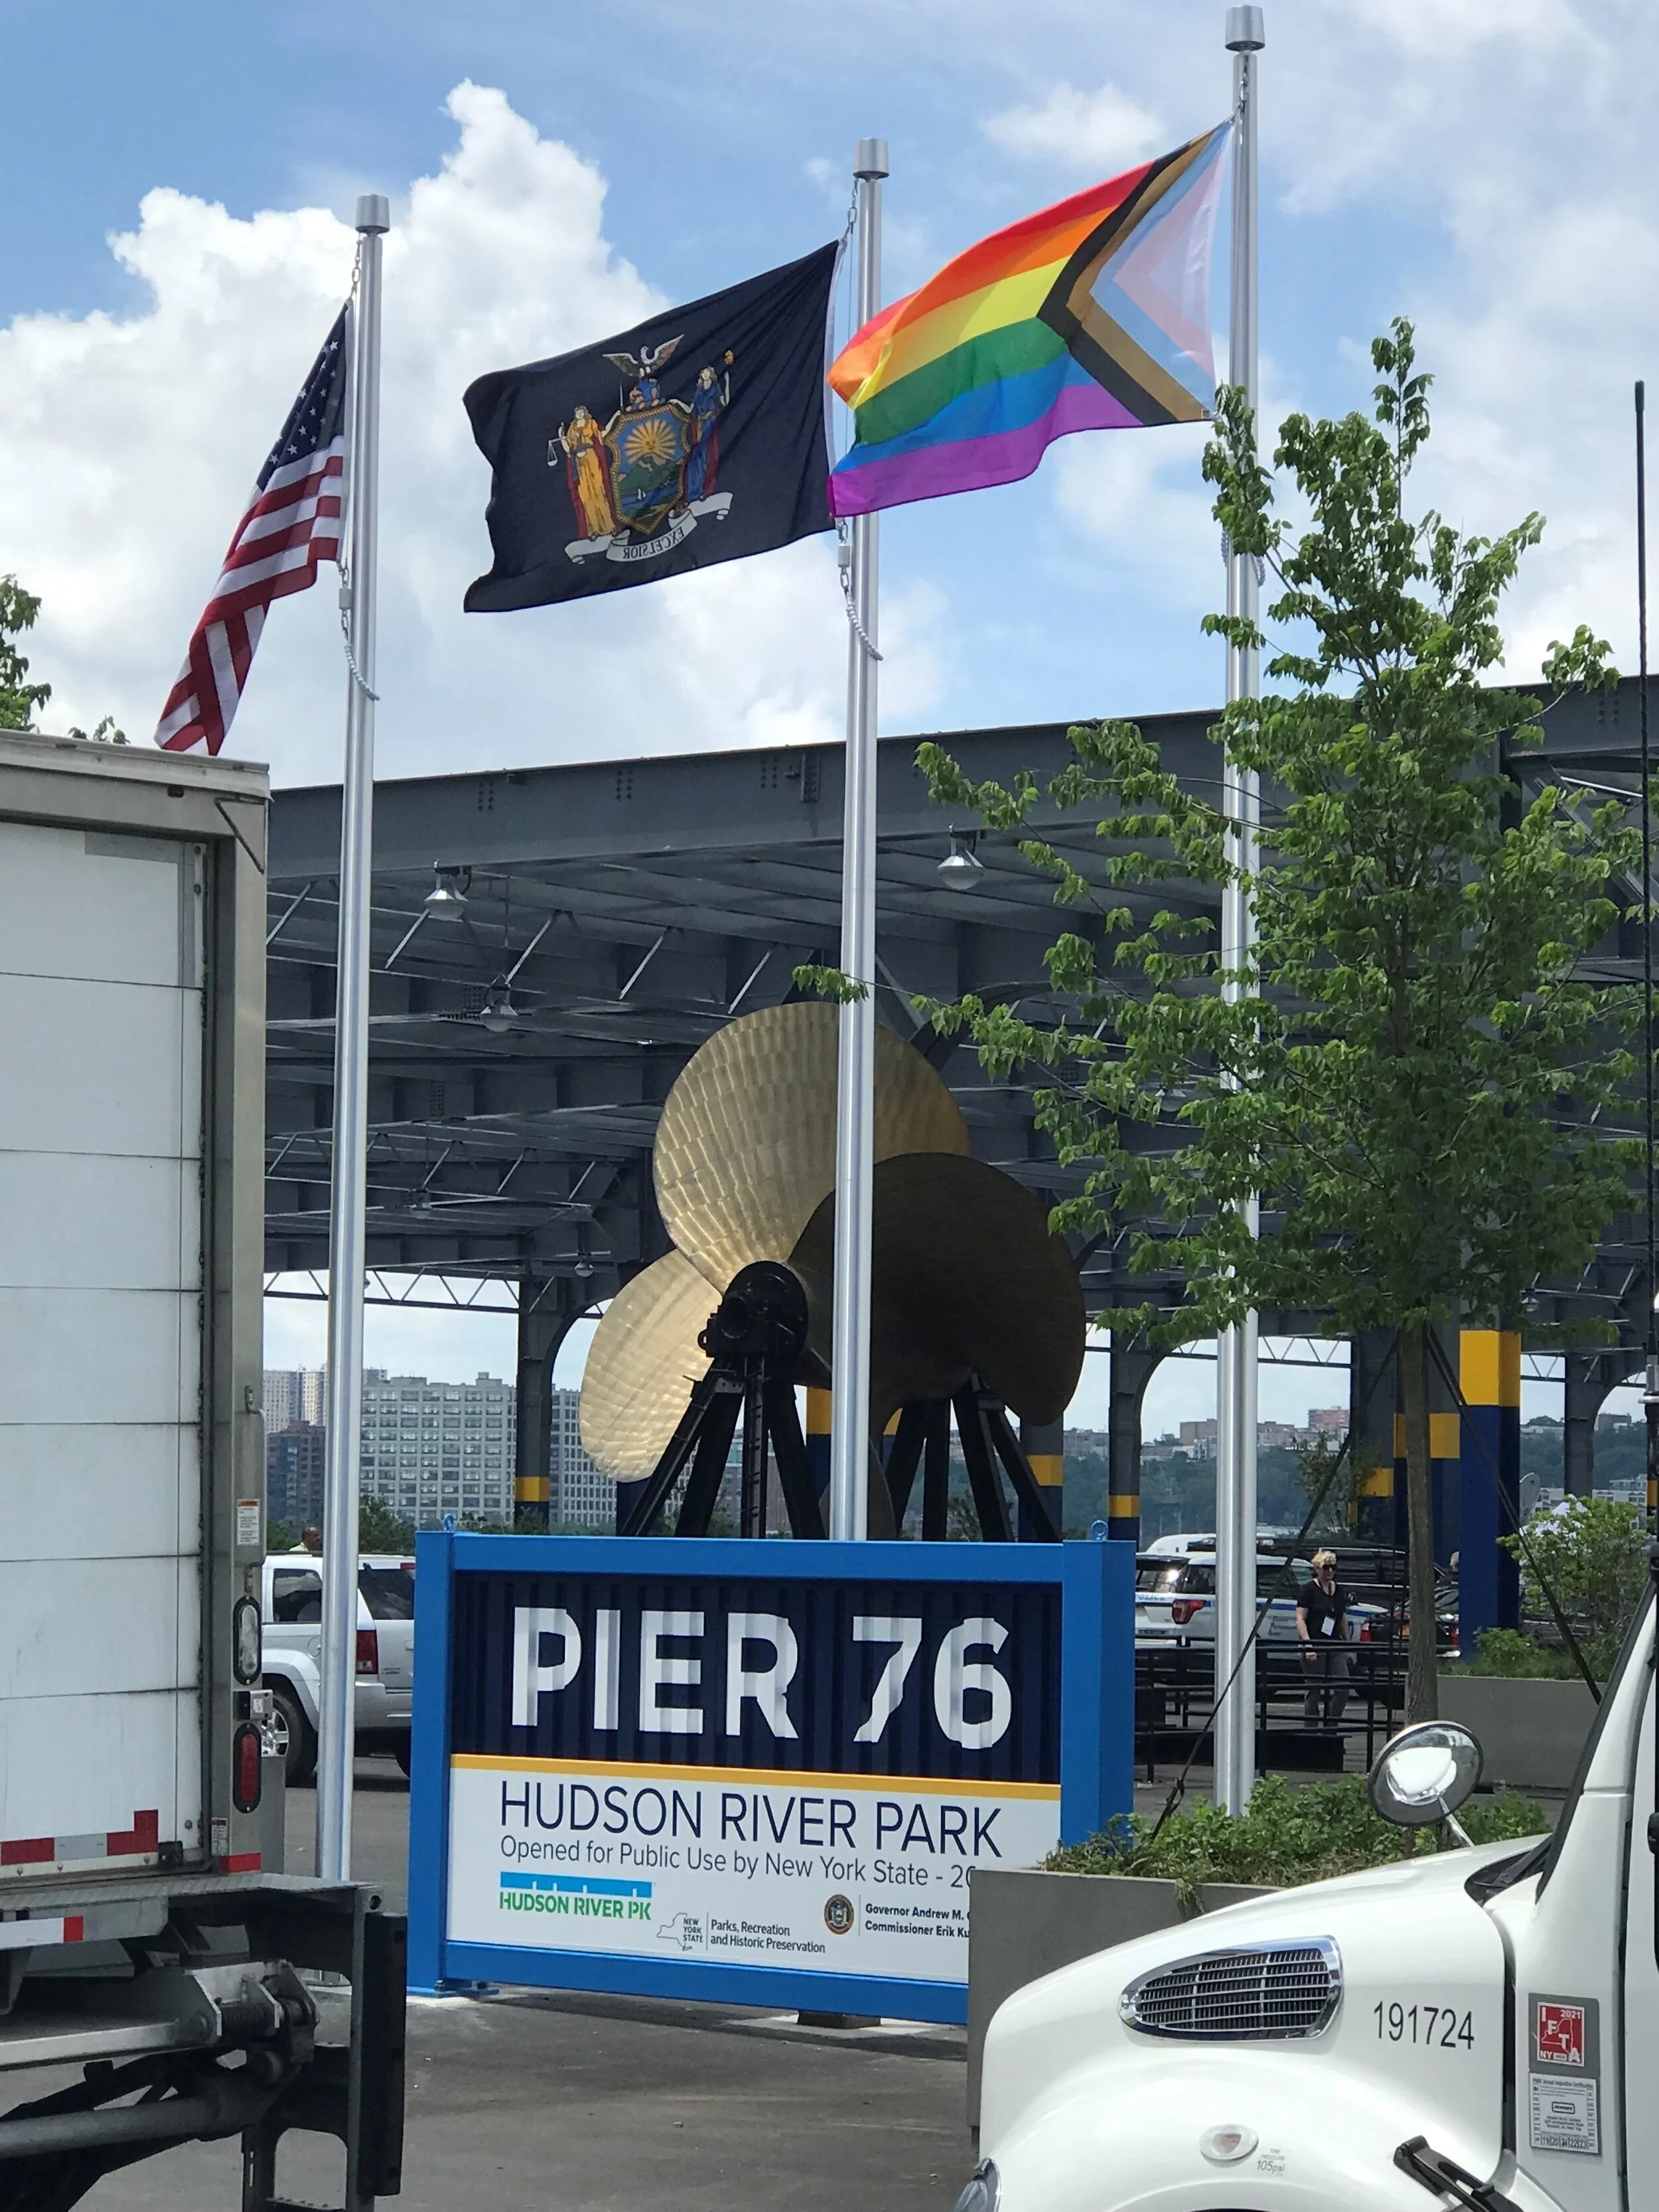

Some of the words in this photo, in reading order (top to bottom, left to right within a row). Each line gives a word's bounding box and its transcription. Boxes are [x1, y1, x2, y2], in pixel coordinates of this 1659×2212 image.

[512, 1607, 798, 1739] PIER
[852, 1616, 1012, 1750] 76
[501, 1780, 701, 1838] HUDSON
[721, 1792, 857, 1849] RIVER
[876, 1801, 1003, 1858] PARK
[500, 1834, 580, 1864] Opened
[586, 1840, 614, 1864] for
[620, 1842, 680, 1870] Public
[687, 1847, 727, 1872] Use
[733, 1850, 758, 1880] by
[765, 1852, 813, 1878] New
[820, 1856, 867, 1882] York
[873, 1859, 928, 1886] State
[499, 1891, 569, 1915] HUDSON
[573, 1897, 624, 1919] RIVER
[628, 1900, 652, 1921] PK
[865, 1903, 910, 1917] Governor
[911, 1906, 950, 1919] Andrew
[952, 1909, 964, 1920] M.
[683, 1917, 699, 1926] NEW
[683, 1926, 702, 1935] YORK
[711, 1919, 739, 1933] Parks,
[741, 1921, 790, 1937] Recreation
[865, 1919, 933, 1935] Commissioner
[936, 1925, 955, 1937] Erik
[683, 1934, 703, 1943] STATE
[710, 1933, 729, 1946] and
[729, 1935, 764, 1949] Historic
[766, 1937, 826, 1954] Preservation
[1561, 2009, 1581, 2020] 2021
[1373, 2000, 1475, 2050] 191724
[1540, 2049, 1553, 2059] NY
[1257, 2160, 1285, 2174] 105psi
